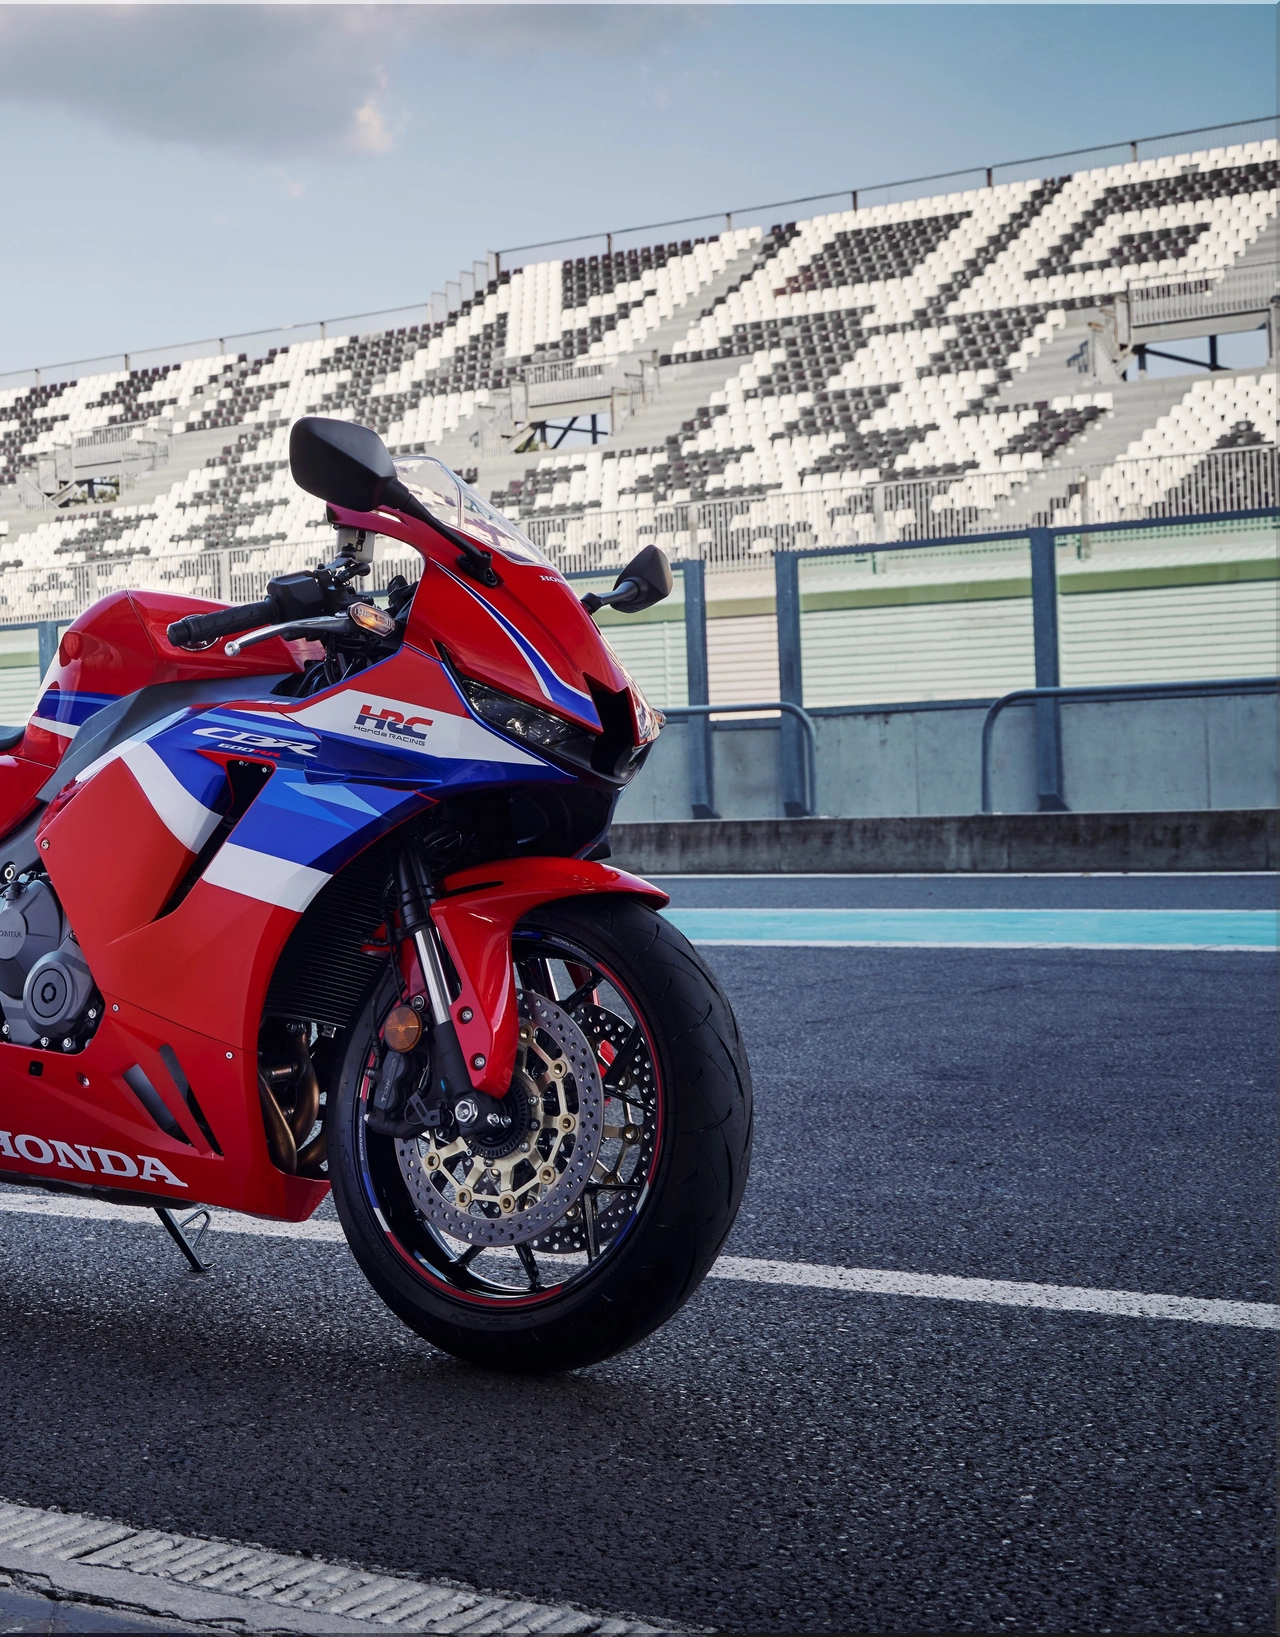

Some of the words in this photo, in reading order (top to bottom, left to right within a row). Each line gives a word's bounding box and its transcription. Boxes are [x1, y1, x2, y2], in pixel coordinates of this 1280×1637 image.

[356, 704, 434, 741] HRC
[192, 727, 318, 759] CBR
[353, 725, 388, 738] Honda
[388, 733, 426, 748] RACING
[217, 743, 282, 759] 600RR
